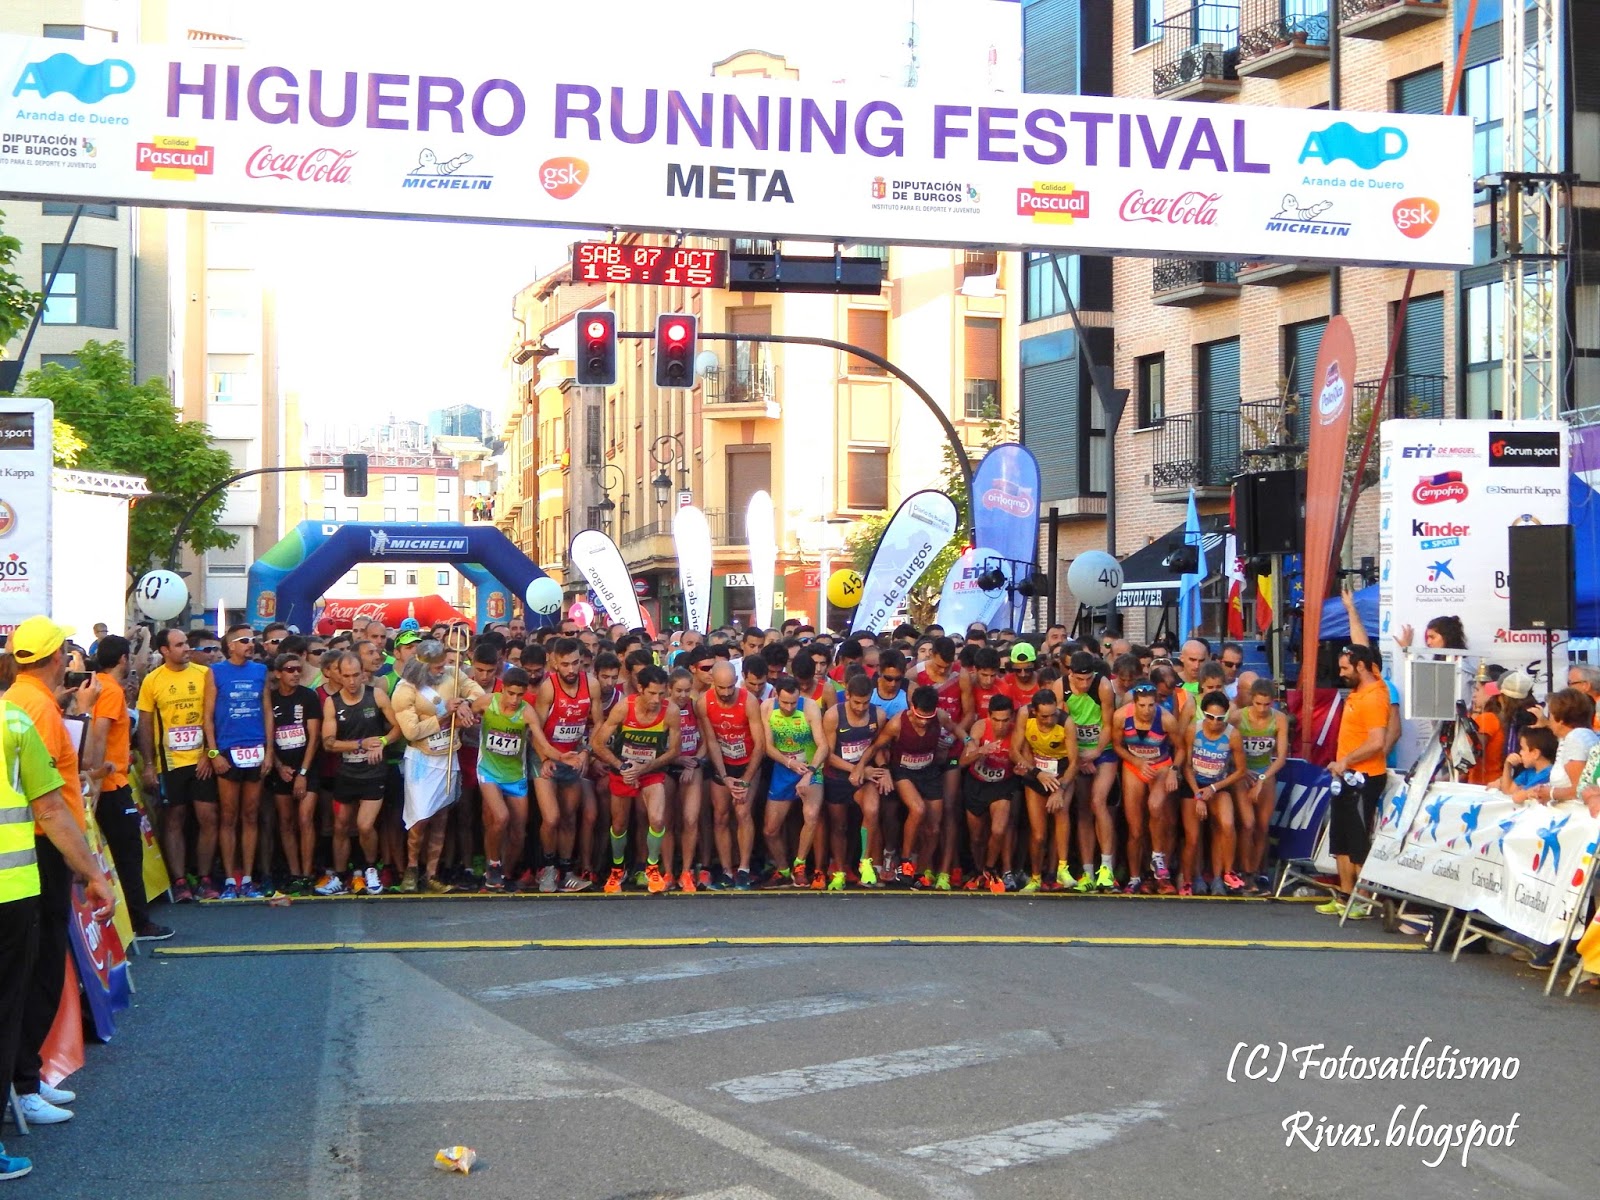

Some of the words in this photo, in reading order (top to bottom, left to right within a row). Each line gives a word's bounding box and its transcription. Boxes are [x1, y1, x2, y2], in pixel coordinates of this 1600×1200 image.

[16, 109, 66, 123] Aranda
[69, 111, 85, 123] de
[89, 113, 129, 125] Duero
[166, 61, 526, 137] HIGUERO
[554, 83, 904, 158] RUNNING
[933, 104, 1271, 174] FESTIVAL
[3, 133, 77, 146] DIPUTACIÓN
[162, 138, 189, 147] Calidad
[2, 145, 19, 154] DE
[25, 146, 77, 157] BURGOS
[140, 149, 208, 167] Pascual
[245, 144, 358, 184] Coca-Cola
[543, 162, 582, 190] gsk
[666, 162, 795, 203] META
[402, 178, 493, 190] MICHELIN
[892, 180, 962, 192] DIPUTACIÓN
[1041, 182, 1067, 192] Calidad
[1302, 176, 1347, 188] Aranda
[1350, 177, 1365, 188] de
[1368, 179, 1404, 190] Duero
[892, 191, 908, 200] DE
[914, 192, 962, 203] BURGOS
[1020, 192, 1084, 211] Pascual
[1119, 188, 1224, 226] Coca-Cola
[1396, 206, 1434, 229] gsk
[1265, 221, 1350, 237] MICHELIN
[580, 245, 621, 264] SAB
[634, 248, 662, 266] 07
[674, 250, 715, 270] OCT
[583, 263, 712, 284] 18:15
[5, 429, 32, 439] sport
[1534, 447, 1558, 457] sport
[5, 467, 35, 479] Kappa
[1500, 486, 1533, 495] Smurfit
[1535, 486, 1561, 497] Kappa
[390, 539, 465, 549] MICHELIN
[728, 574, 755, 586] BA
[883, 589, 899, 607] de
[895, 542, 933, 588] Burgos
[1416, 585, 1439, 594] Obra
[1440, 584, 1466, 594] Social
[1115, 590, 1163, 607] REVOLVER
[175, 702, 194, 710] TEAM
[174, 730, 198, 743] 337
[559, 727, 581, 735] SAUL
[488, 735, 518, 749] 1471
[1243, 740, 1274, 751] 1794
[236, 748, 260, 761] 504
